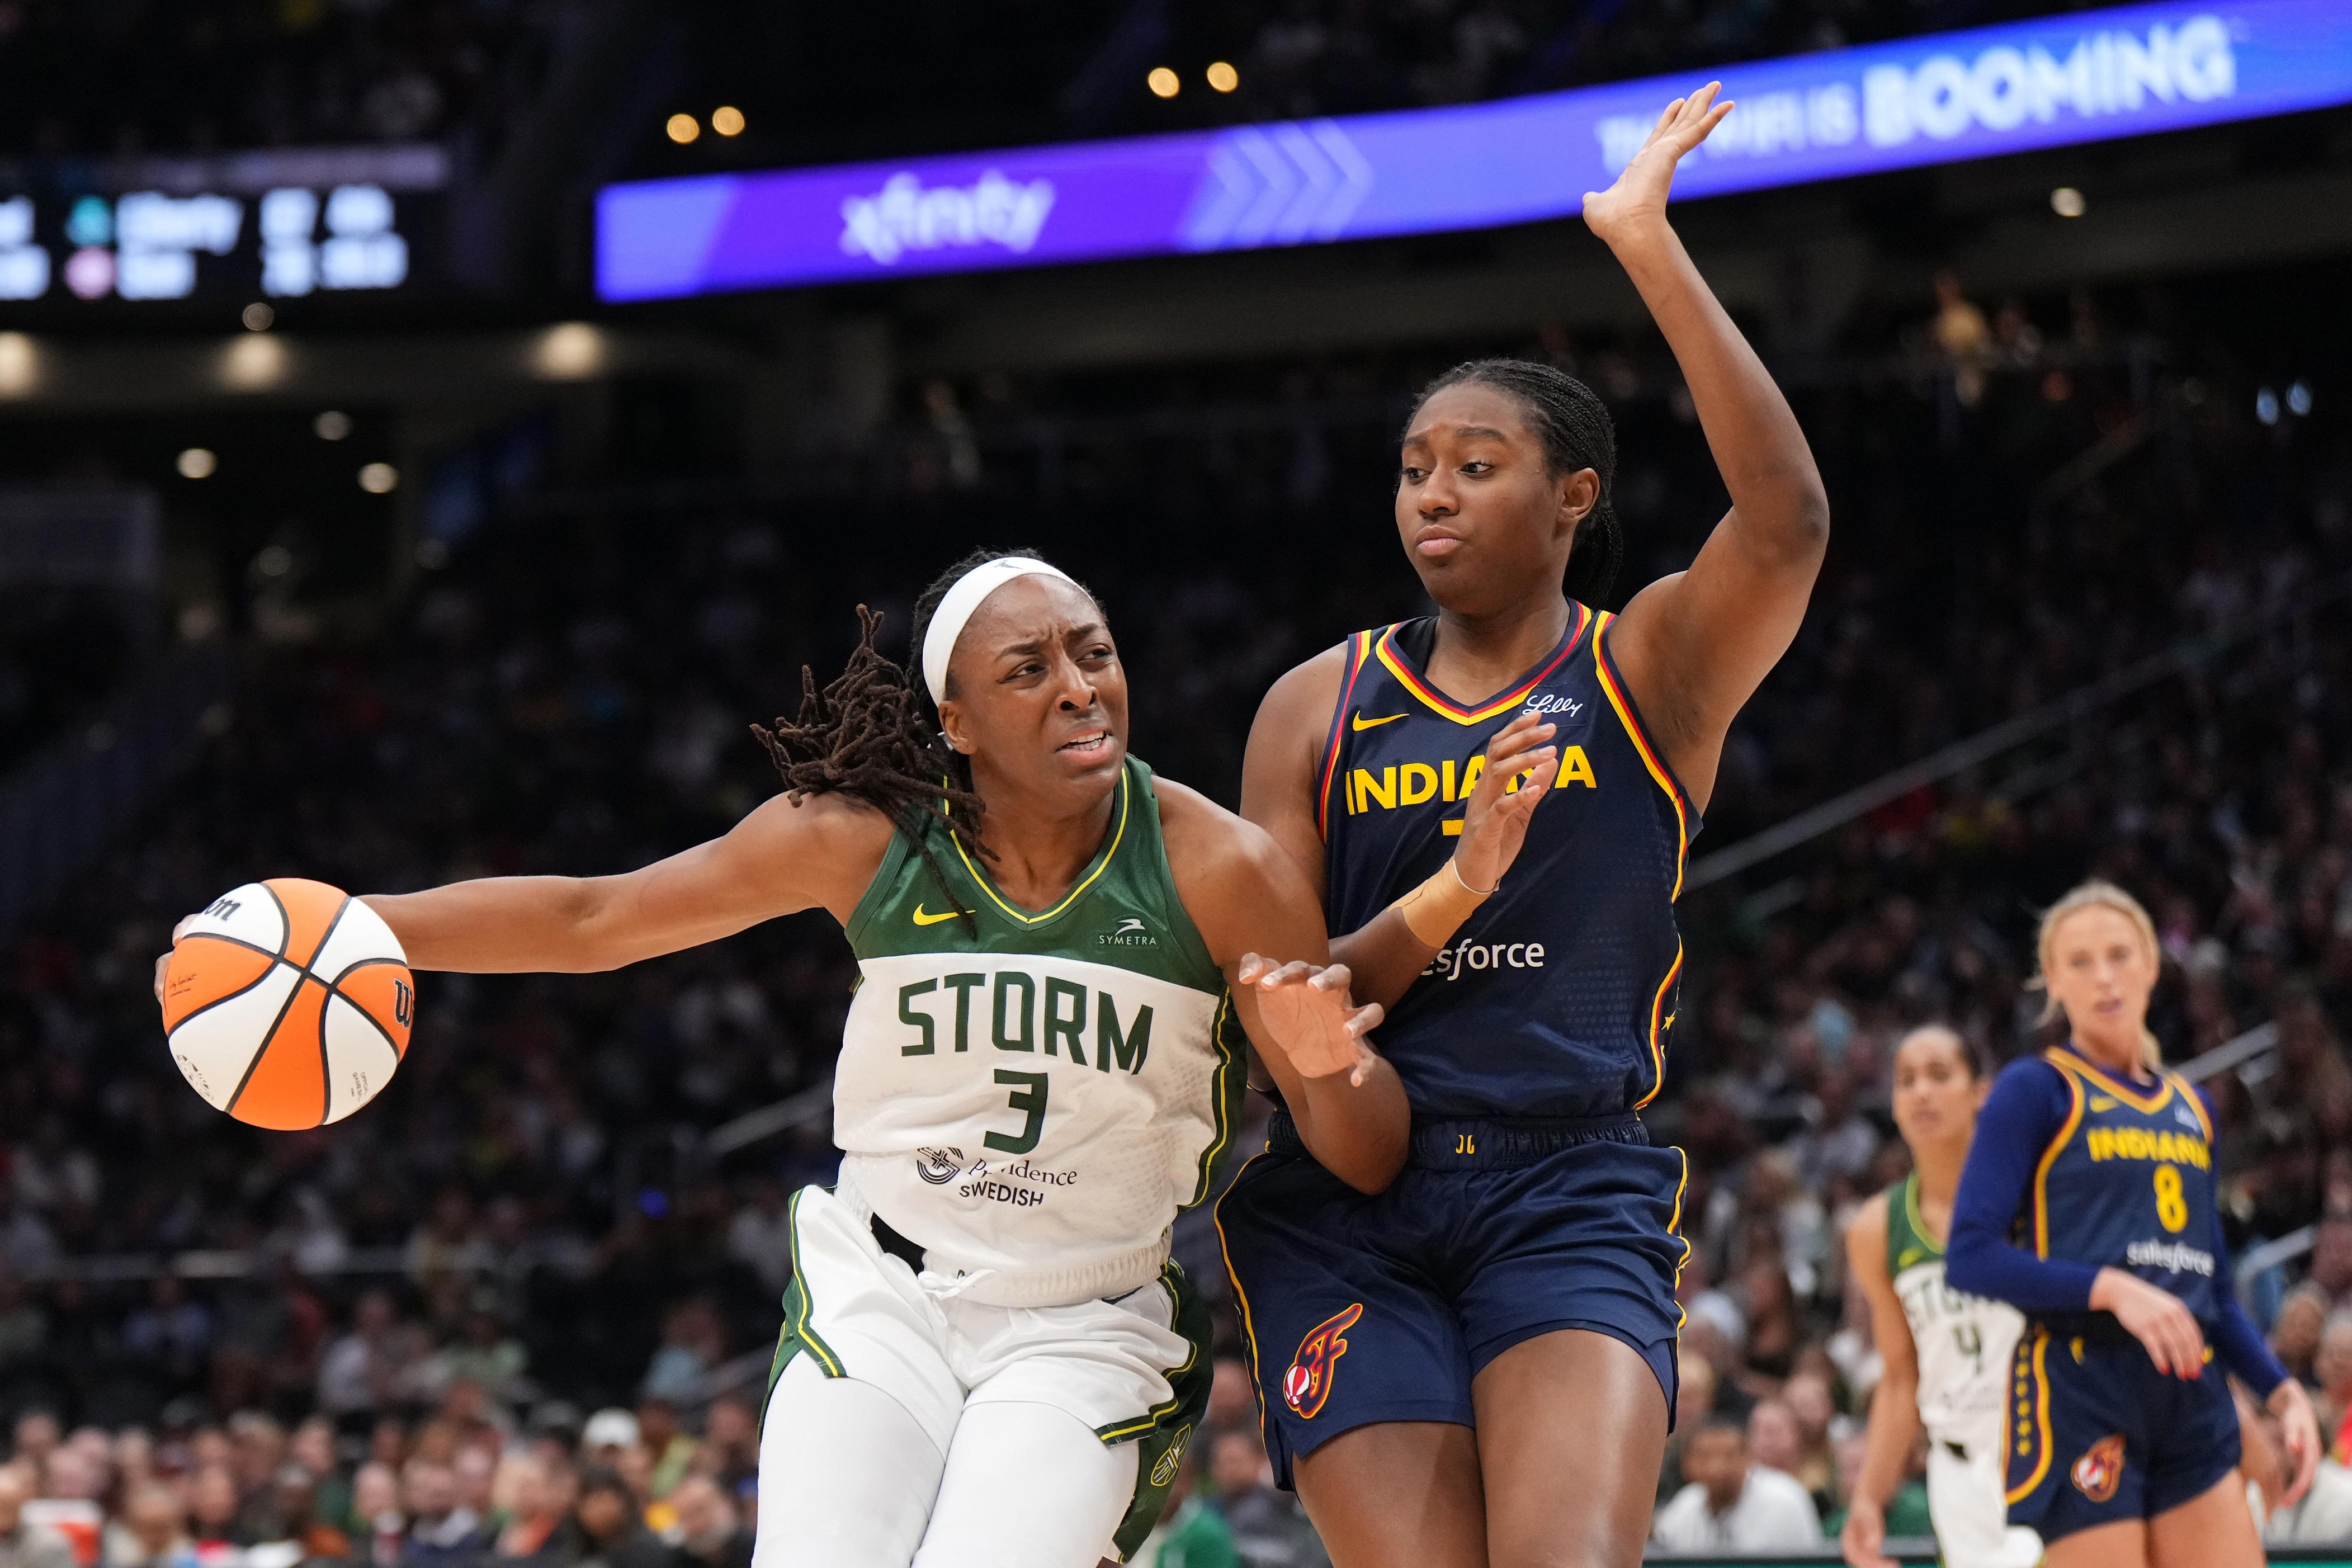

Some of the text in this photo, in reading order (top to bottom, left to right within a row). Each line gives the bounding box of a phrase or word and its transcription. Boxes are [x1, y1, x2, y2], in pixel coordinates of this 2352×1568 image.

[1805, 83, 1858, 147] IS
[1862, 15, 2235, 149] BOOMING
[840, 169, 1056, 265] xfinity
[1522, 694, 1583, 717] Lilly
[1099, 935, 1156, 945] SYMETRA
[899, 971, 1154, 1075] STORM
[983, 1069, 1049, 1154] 3
[958, 1180, 1044, 1207] SWEDISH
[2153, 1163, 2188, 1234] 8
[1952, 1323, 1983, 1376] 4
